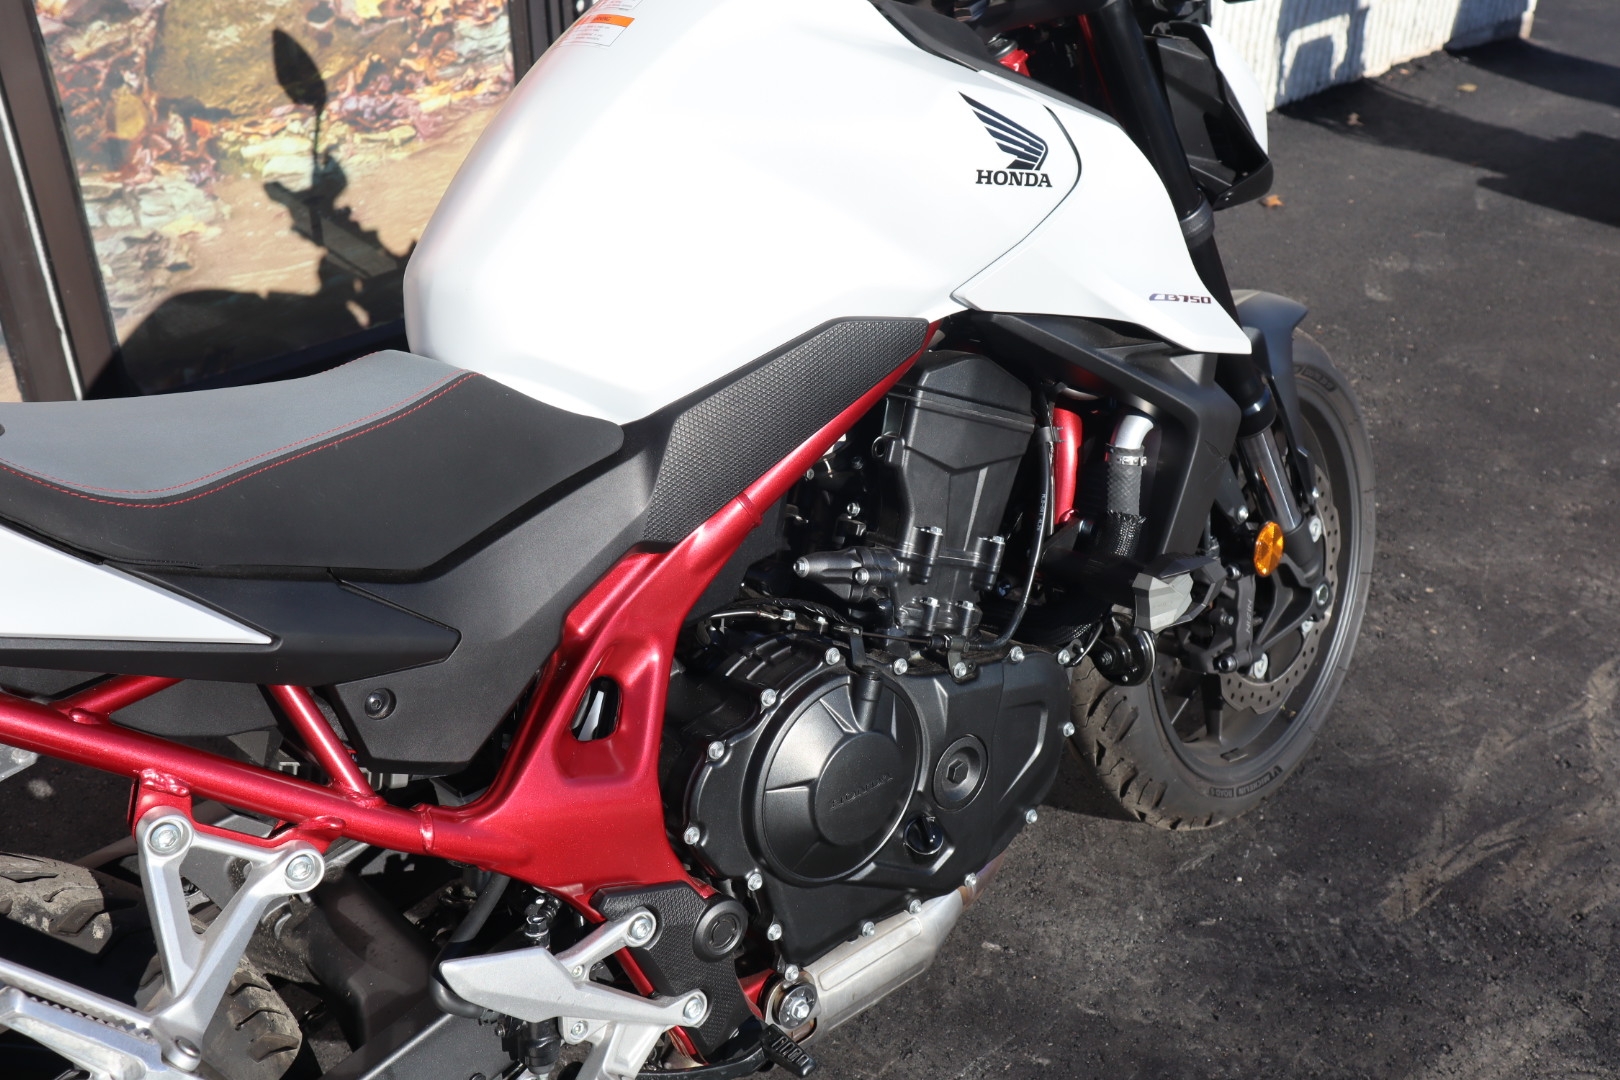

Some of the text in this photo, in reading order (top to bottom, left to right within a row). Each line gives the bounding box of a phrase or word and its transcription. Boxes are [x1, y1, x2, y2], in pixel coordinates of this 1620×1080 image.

[975, 169, 1053, 187] HONDA
[1149, 293, 1212, 304] CB750
[1238, 773, 1271, 795] MICHELIN
